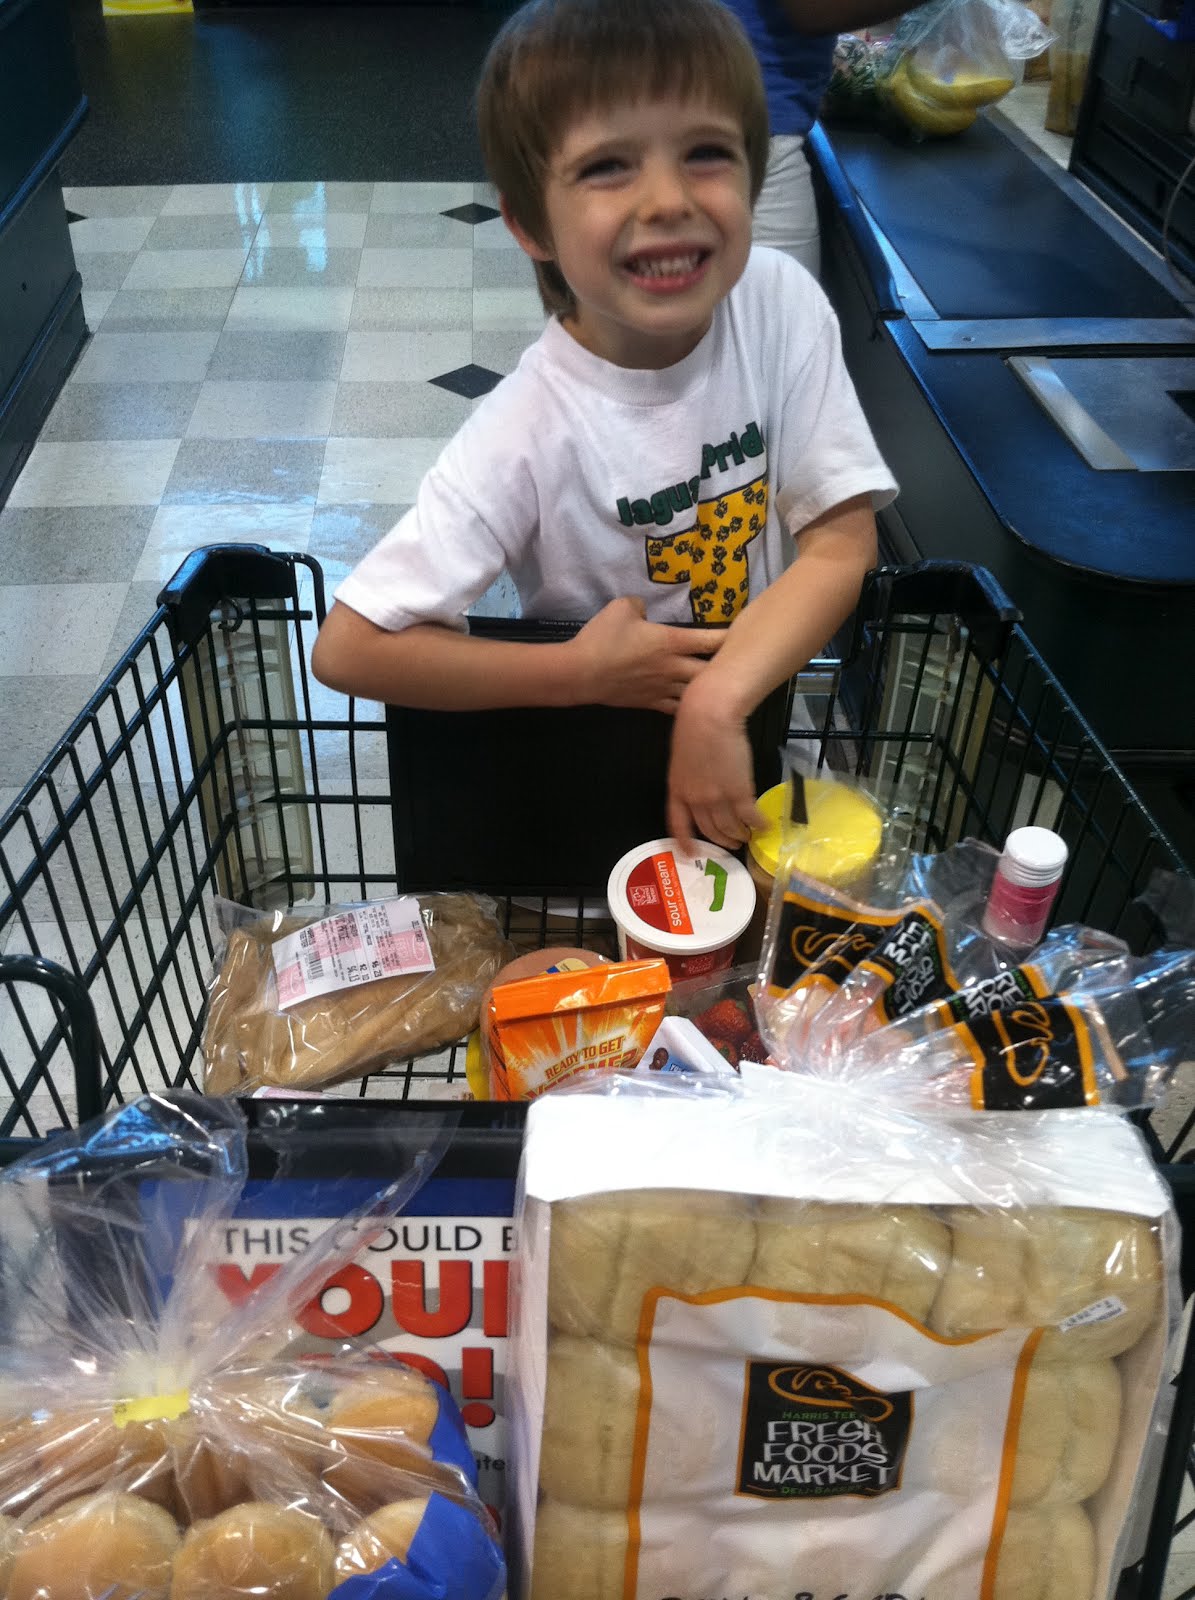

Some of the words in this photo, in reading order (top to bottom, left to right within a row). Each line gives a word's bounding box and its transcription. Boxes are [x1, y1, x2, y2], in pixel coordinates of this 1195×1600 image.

[700, 420, 765, 479] Prid
[657, 860, 674, 897] cream
[666, 901, 682, 926] sour
[544, 1052, 580, 1080] READY
[581, 1047, 596, 1060] TO
[599, 1035, 625, 1054] GET
[224, 1227, 311, 1255] THIS
[783, 1410, 829, 1420] HARRIS
[767, 1419, 882, 1445] FRESH
[763, 1442, 888, 1464] FOODS
[754, 1461, 895, 1486] MARKET
